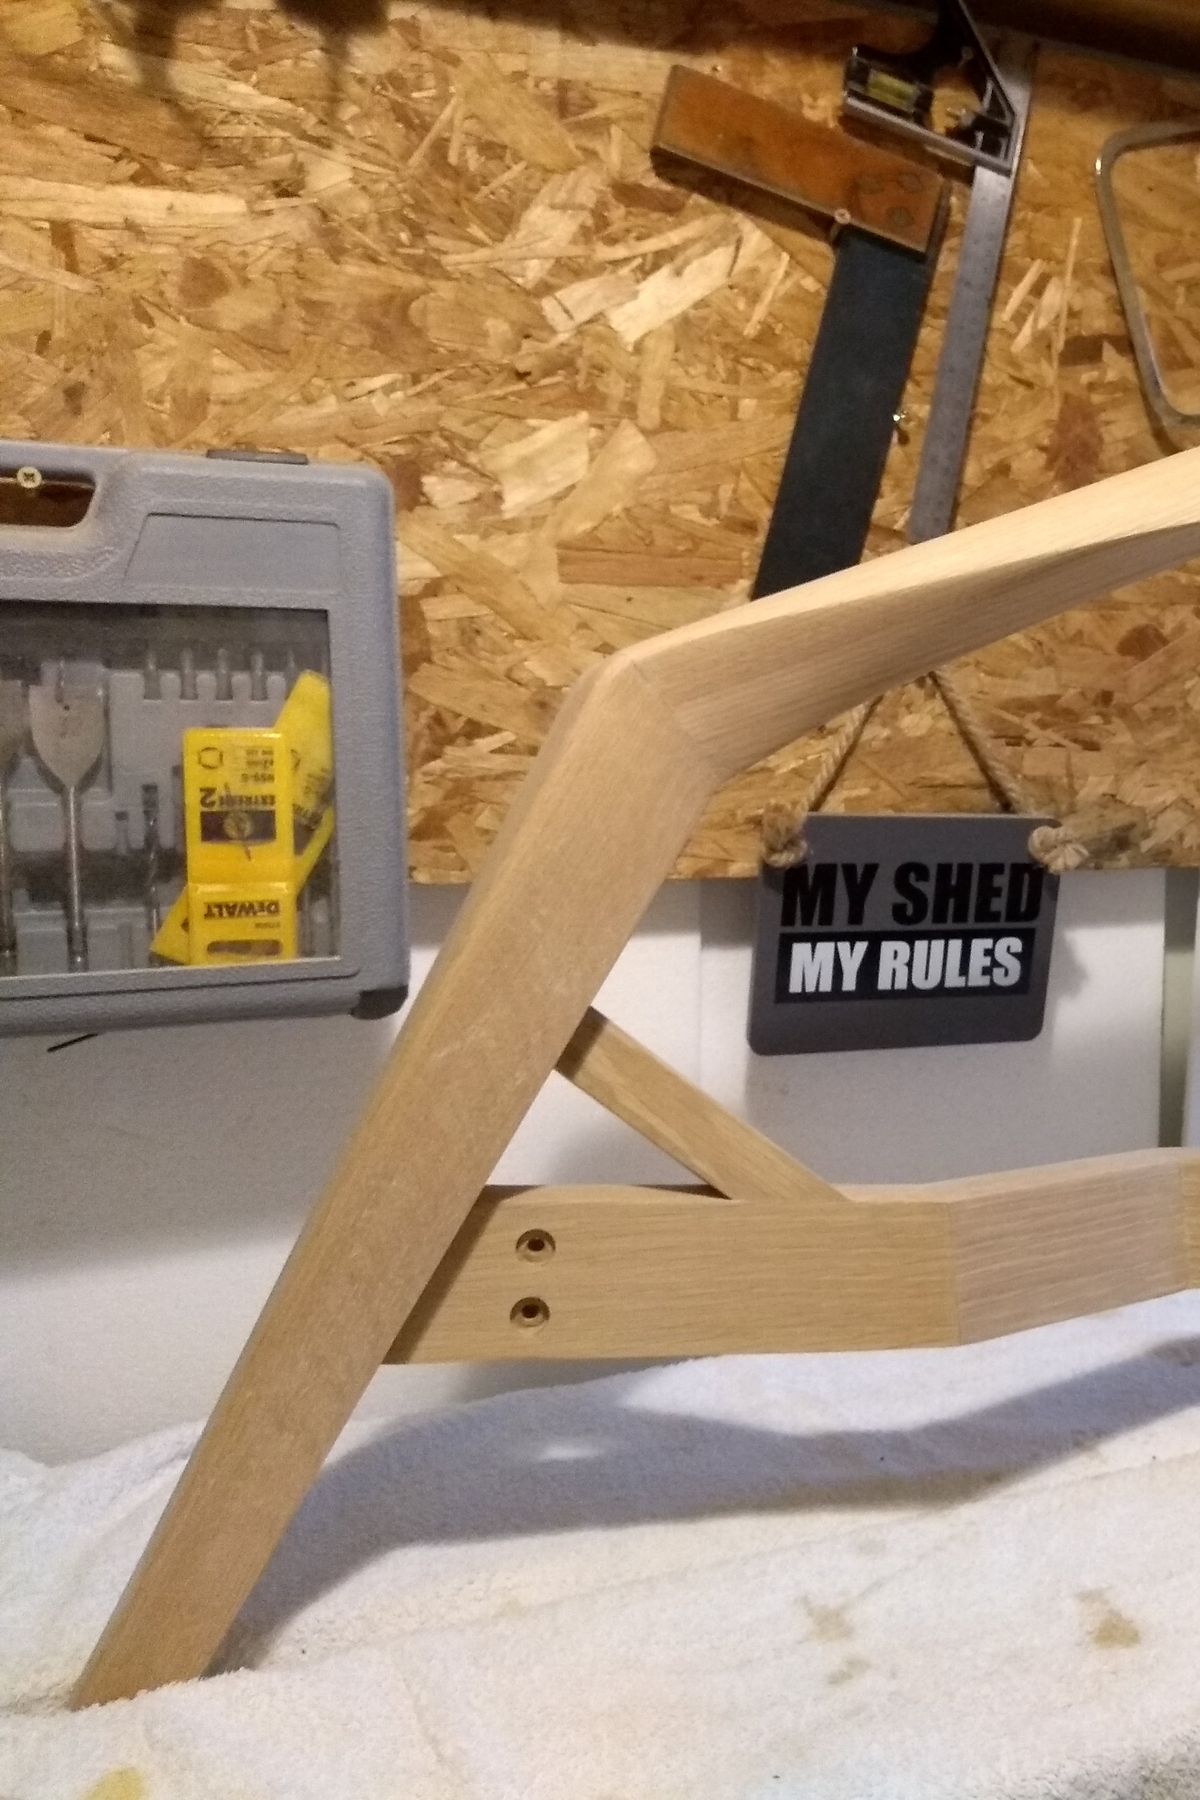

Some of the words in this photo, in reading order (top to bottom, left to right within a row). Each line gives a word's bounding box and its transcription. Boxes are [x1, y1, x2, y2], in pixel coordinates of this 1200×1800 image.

[199, 787, 217, 809] 2
[203, 901, 281, 919] DEWALT
[781, 863, 879, 927] MY
[891, 861, 1044, 926] SHED
[789, 941, 869, 993] MY
[877, 936, 1023, 991] RULES
